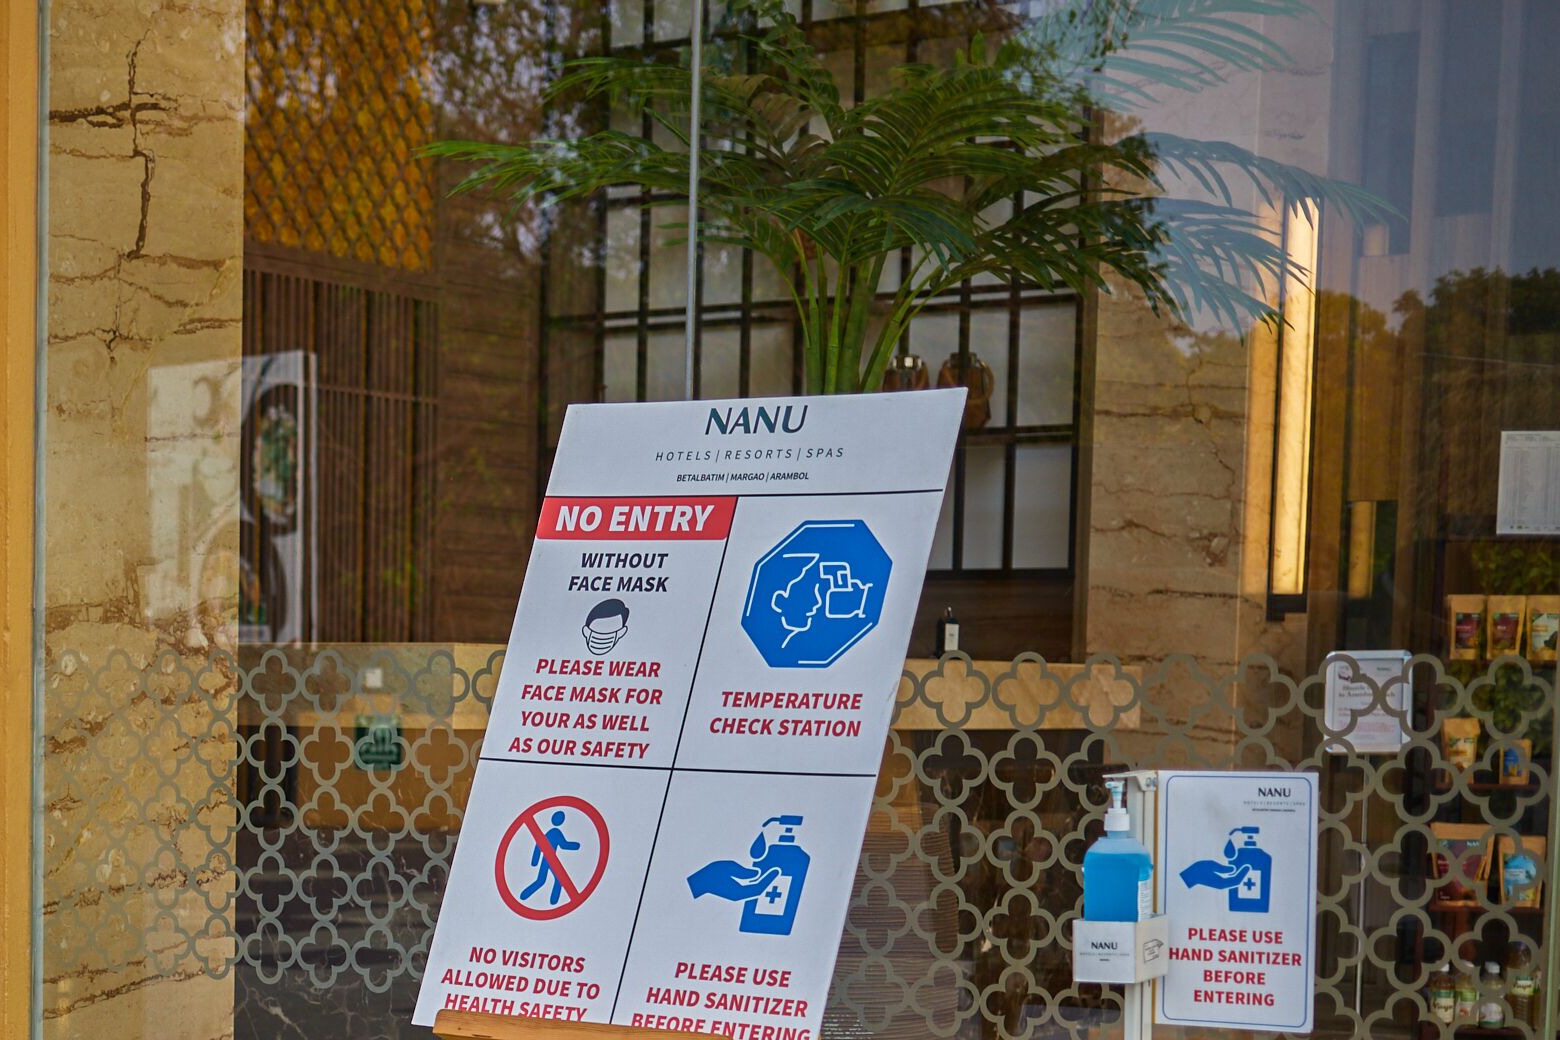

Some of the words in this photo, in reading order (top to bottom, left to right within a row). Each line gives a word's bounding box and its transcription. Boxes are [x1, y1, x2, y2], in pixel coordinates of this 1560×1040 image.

[704, 404, 809, 436] NANU
[655, 450, 712, 462] HOTELS
[724, 448, 793, 460] RESORTS
[805, 447, 844, 459] SPAS
[676, 473, 726, 483] BETALBATIM
[729, 472, 765, 481] MARGAO
[769, 471, 809, 481] ARAMBOL
[555, 505, 603, 533] NO
[608, 504, 715, 532] ENTRY
[581, 552, 669, 569] WITHOUT
[567, 575, 614, 592] FACE
[616, 576, 670, 593] MASK
[535, 658, 605, 676] PLEASE
[608, 660, 661, 678] WEAR
[521, 684, 567, 702] FACE
[569, 686, 622, 704] MASK
[624, 688, 663, 705] FOR
[721, 691, 864, 710] TEMPERATURE
[521, 710, 571, 729] YOUR
[572, 713, 598, 730] AS
[601, 714, 650, 732] WELL
[709, 717, 775, 736] CHECK
[777, 718, 862, 737] STATION
[507, 736, 534, 754] AS
[536, 738, 577, 756] OUR
[580, 740, 650, 759] SAFETY
[1257, 787, 1292, 798] NANU
[1090, 941, 1118, 951] NANU
[1187, 927, 1248, 943] PLEASE
[1252, 930, 1283, 945] USE
[468, 946, 497, 965] NO
[502, 949, 586, 974] VISITORS
[1168, 946, 1214, 962] HAND
[1217, 949, 1302, 967] SANITIZER
[440, 968, 529, 993] ALLOWED
[532, 977, 572, 998] DUE
[576, 981, 601, 1000] TO
[674, 961, 749, 984] PLEASE
[752, 968, 792, 988] USE
[1203, 969, 1266, 986] BEFORE
[645, 986, 701, 1008] HAND
[703, 991, 809, 1018] SANITIZER
[1193, 989, 1275, 1007] ENTERING
